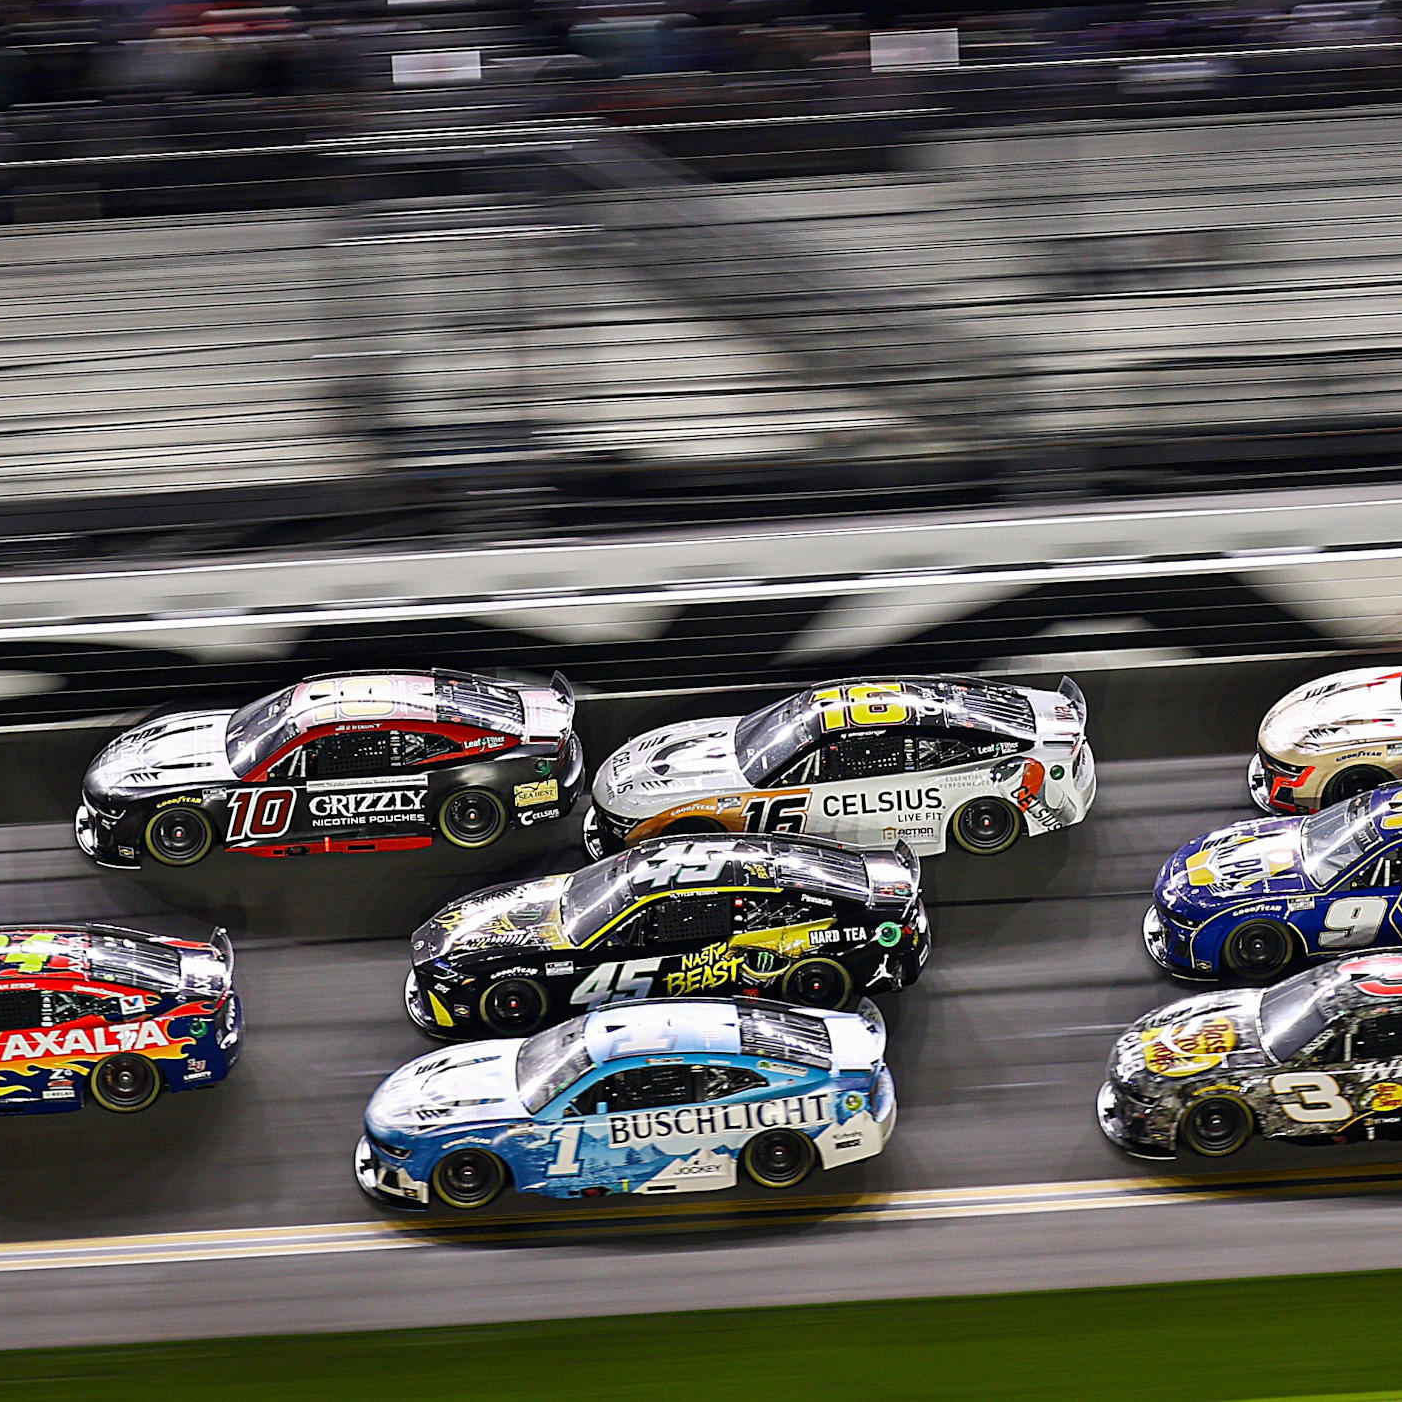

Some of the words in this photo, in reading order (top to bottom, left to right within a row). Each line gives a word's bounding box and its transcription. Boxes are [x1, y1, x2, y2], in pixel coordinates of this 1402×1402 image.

[811, 682, 912, 733] 16
[1336, 750, 1383, 763] GOODYEAR
[156, 796, 203, 809] GOODYEAR
[225, 787, 297, 842] 10
[308, 789, 426, 817] GRIZZLY
[670, 803, 717, 817] GOODYEAR
[741, 794, 812, 834] 16
[822, 787, 942, 818] CELSIUS
[898, 813, 926, 823] LIVE
[927, 811, 943, 822] FIT
[1009, 785, 1062, 832] CELSIUS
[312, 815, 366, 827] NICOTINE
[369, 812, 426, 824] POUCHES
[800, 893, 834, 907] Pinnacle
[1232, 903, 1283, 917] GOODYEAR
[810, 929, 840, 945] HARD
[843, 927, 868, 941] TEA
[1318, 896, 1389, 948] 9
[681, 942, 728, 972] NASTY
[570, 957, 667, 1007] 45
[665, 957, 745, 997] BEAST
[1, 1020, 170, 1061] AXALTA
[1270, 1072, 1354, 1123] 3
[609, 1105, 721, 1145] BUSCH
[720, 1094, 829, 1131] LIGHT
[545, 1119, 586, 1178] 1
[673, 1164, 723, 1176] JOCKEY
